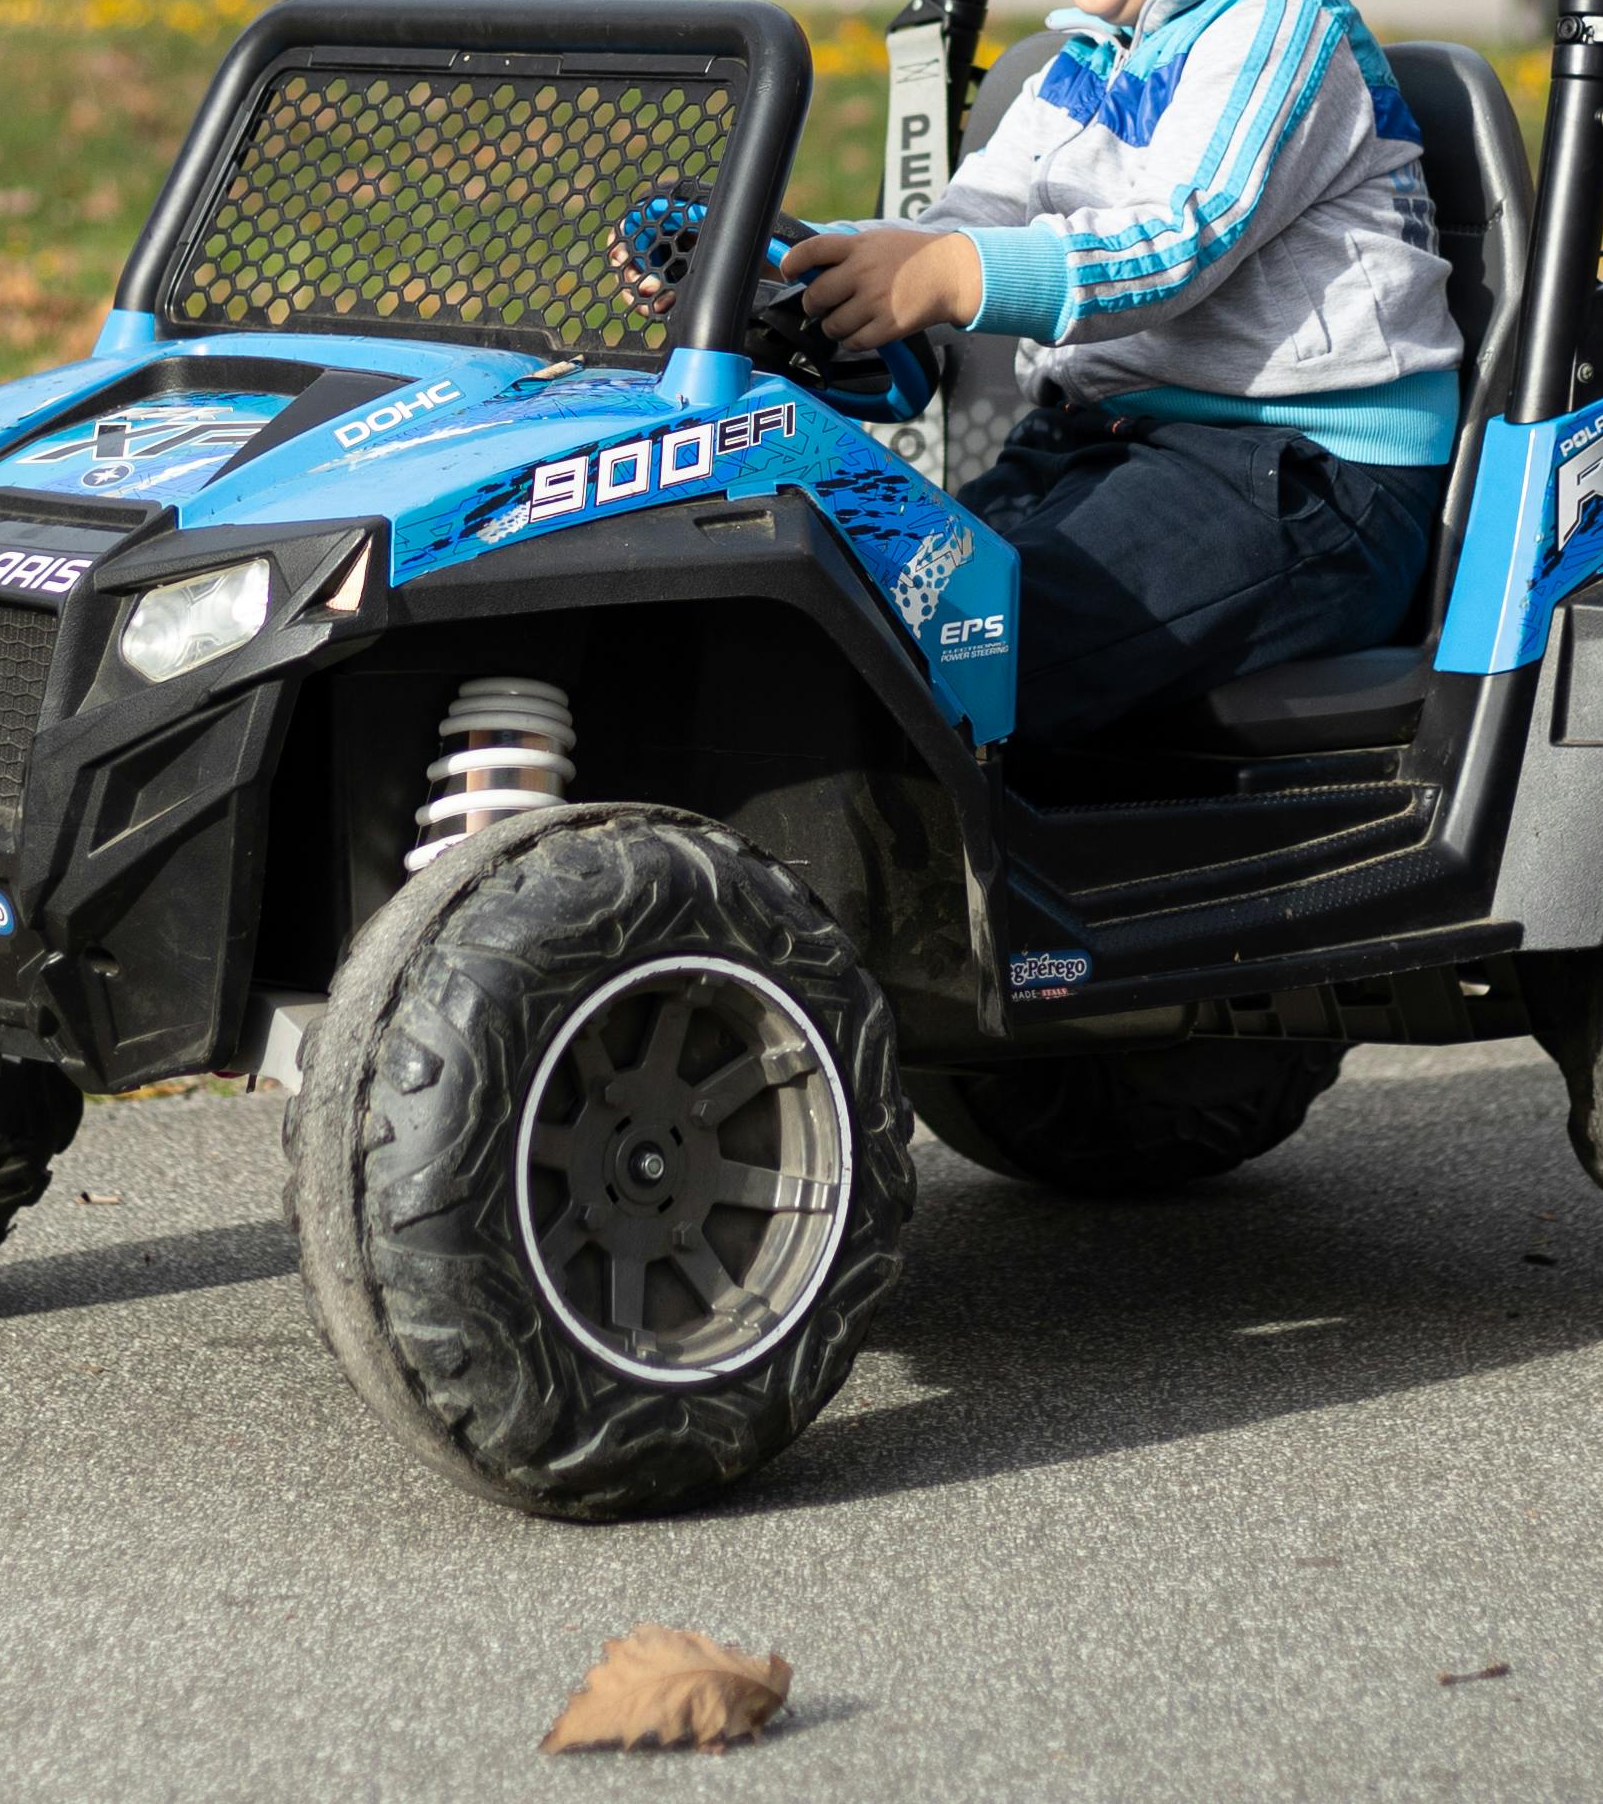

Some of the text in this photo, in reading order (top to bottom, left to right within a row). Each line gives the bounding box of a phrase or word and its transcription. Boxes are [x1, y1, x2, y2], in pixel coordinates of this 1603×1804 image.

[333, 380, 461, 449] DOHC
[528, 423, 715, 524] 900
[716, 401, 796, 456] EFI
[940, 614, 1005, 645] EPS
[940, 645, 1010, 663] POWER STEERING
